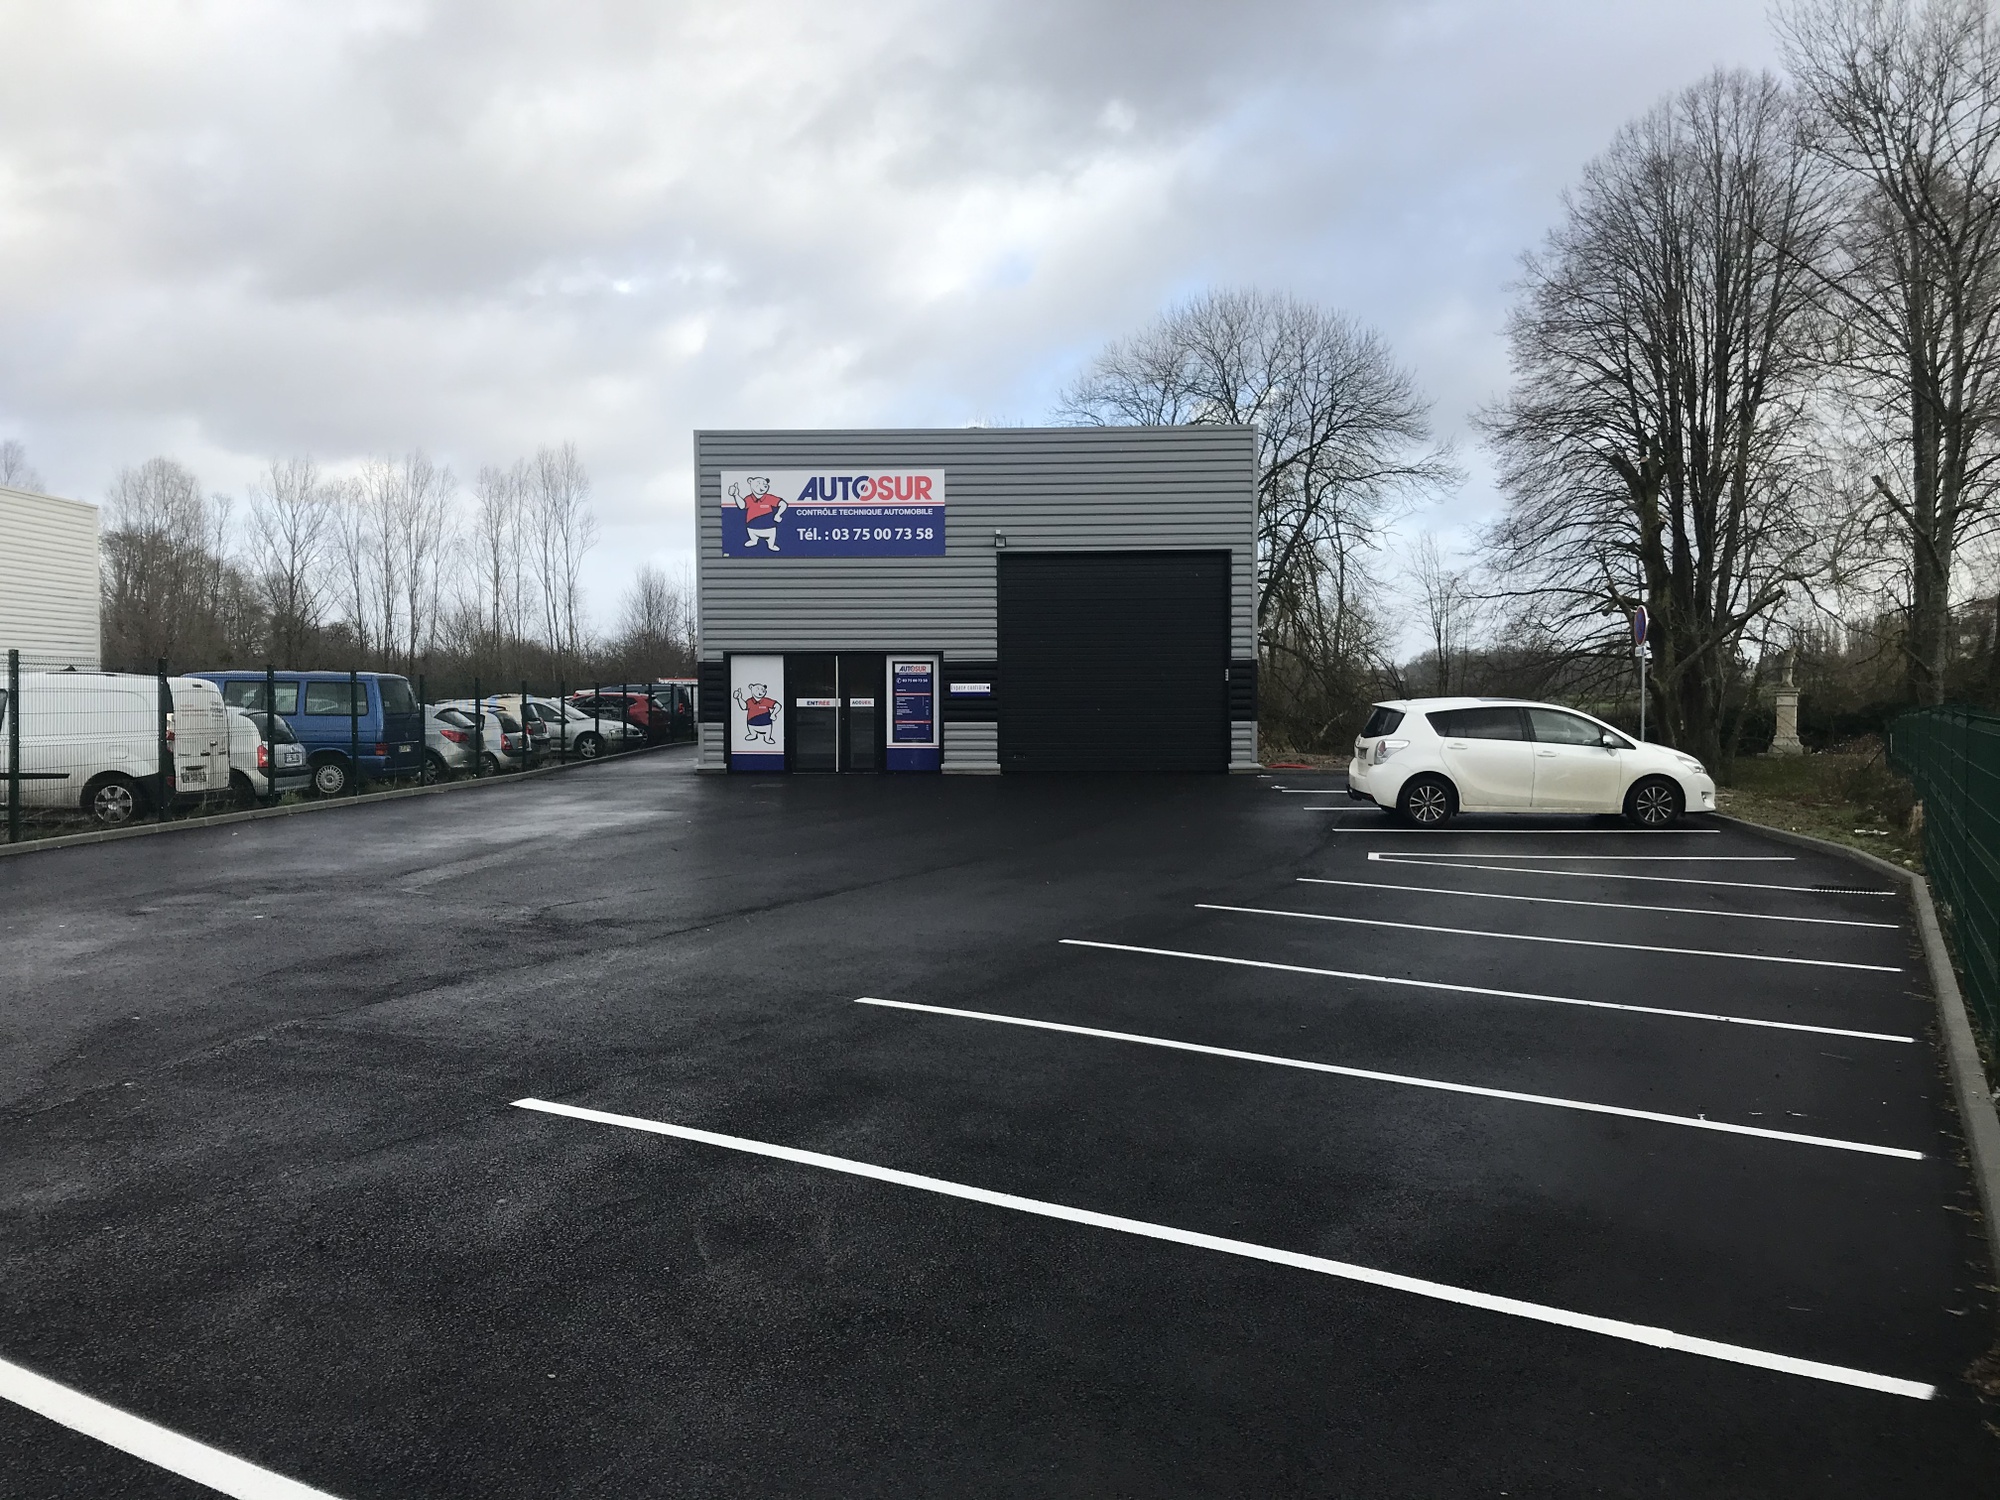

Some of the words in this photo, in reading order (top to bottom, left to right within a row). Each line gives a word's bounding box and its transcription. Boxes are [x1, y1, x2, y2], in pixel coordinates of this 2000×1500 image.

[797, 475, 932, 501] AUTOSUR
[796, 507, 837, 516] CONTRÔLE
[839, 508, 882, 516] TECHNIQUE
[883, 508, 933, 516] AUTOMOBILE
[797, 527, 822, 541] Tél.
[831, 528, 850, 541] 03
[853, 528, 870, 541] 75
[873, 528, 891, 541] 00
[895, 528, 912, 540] 73
[916, 527, 934, 540] 58
